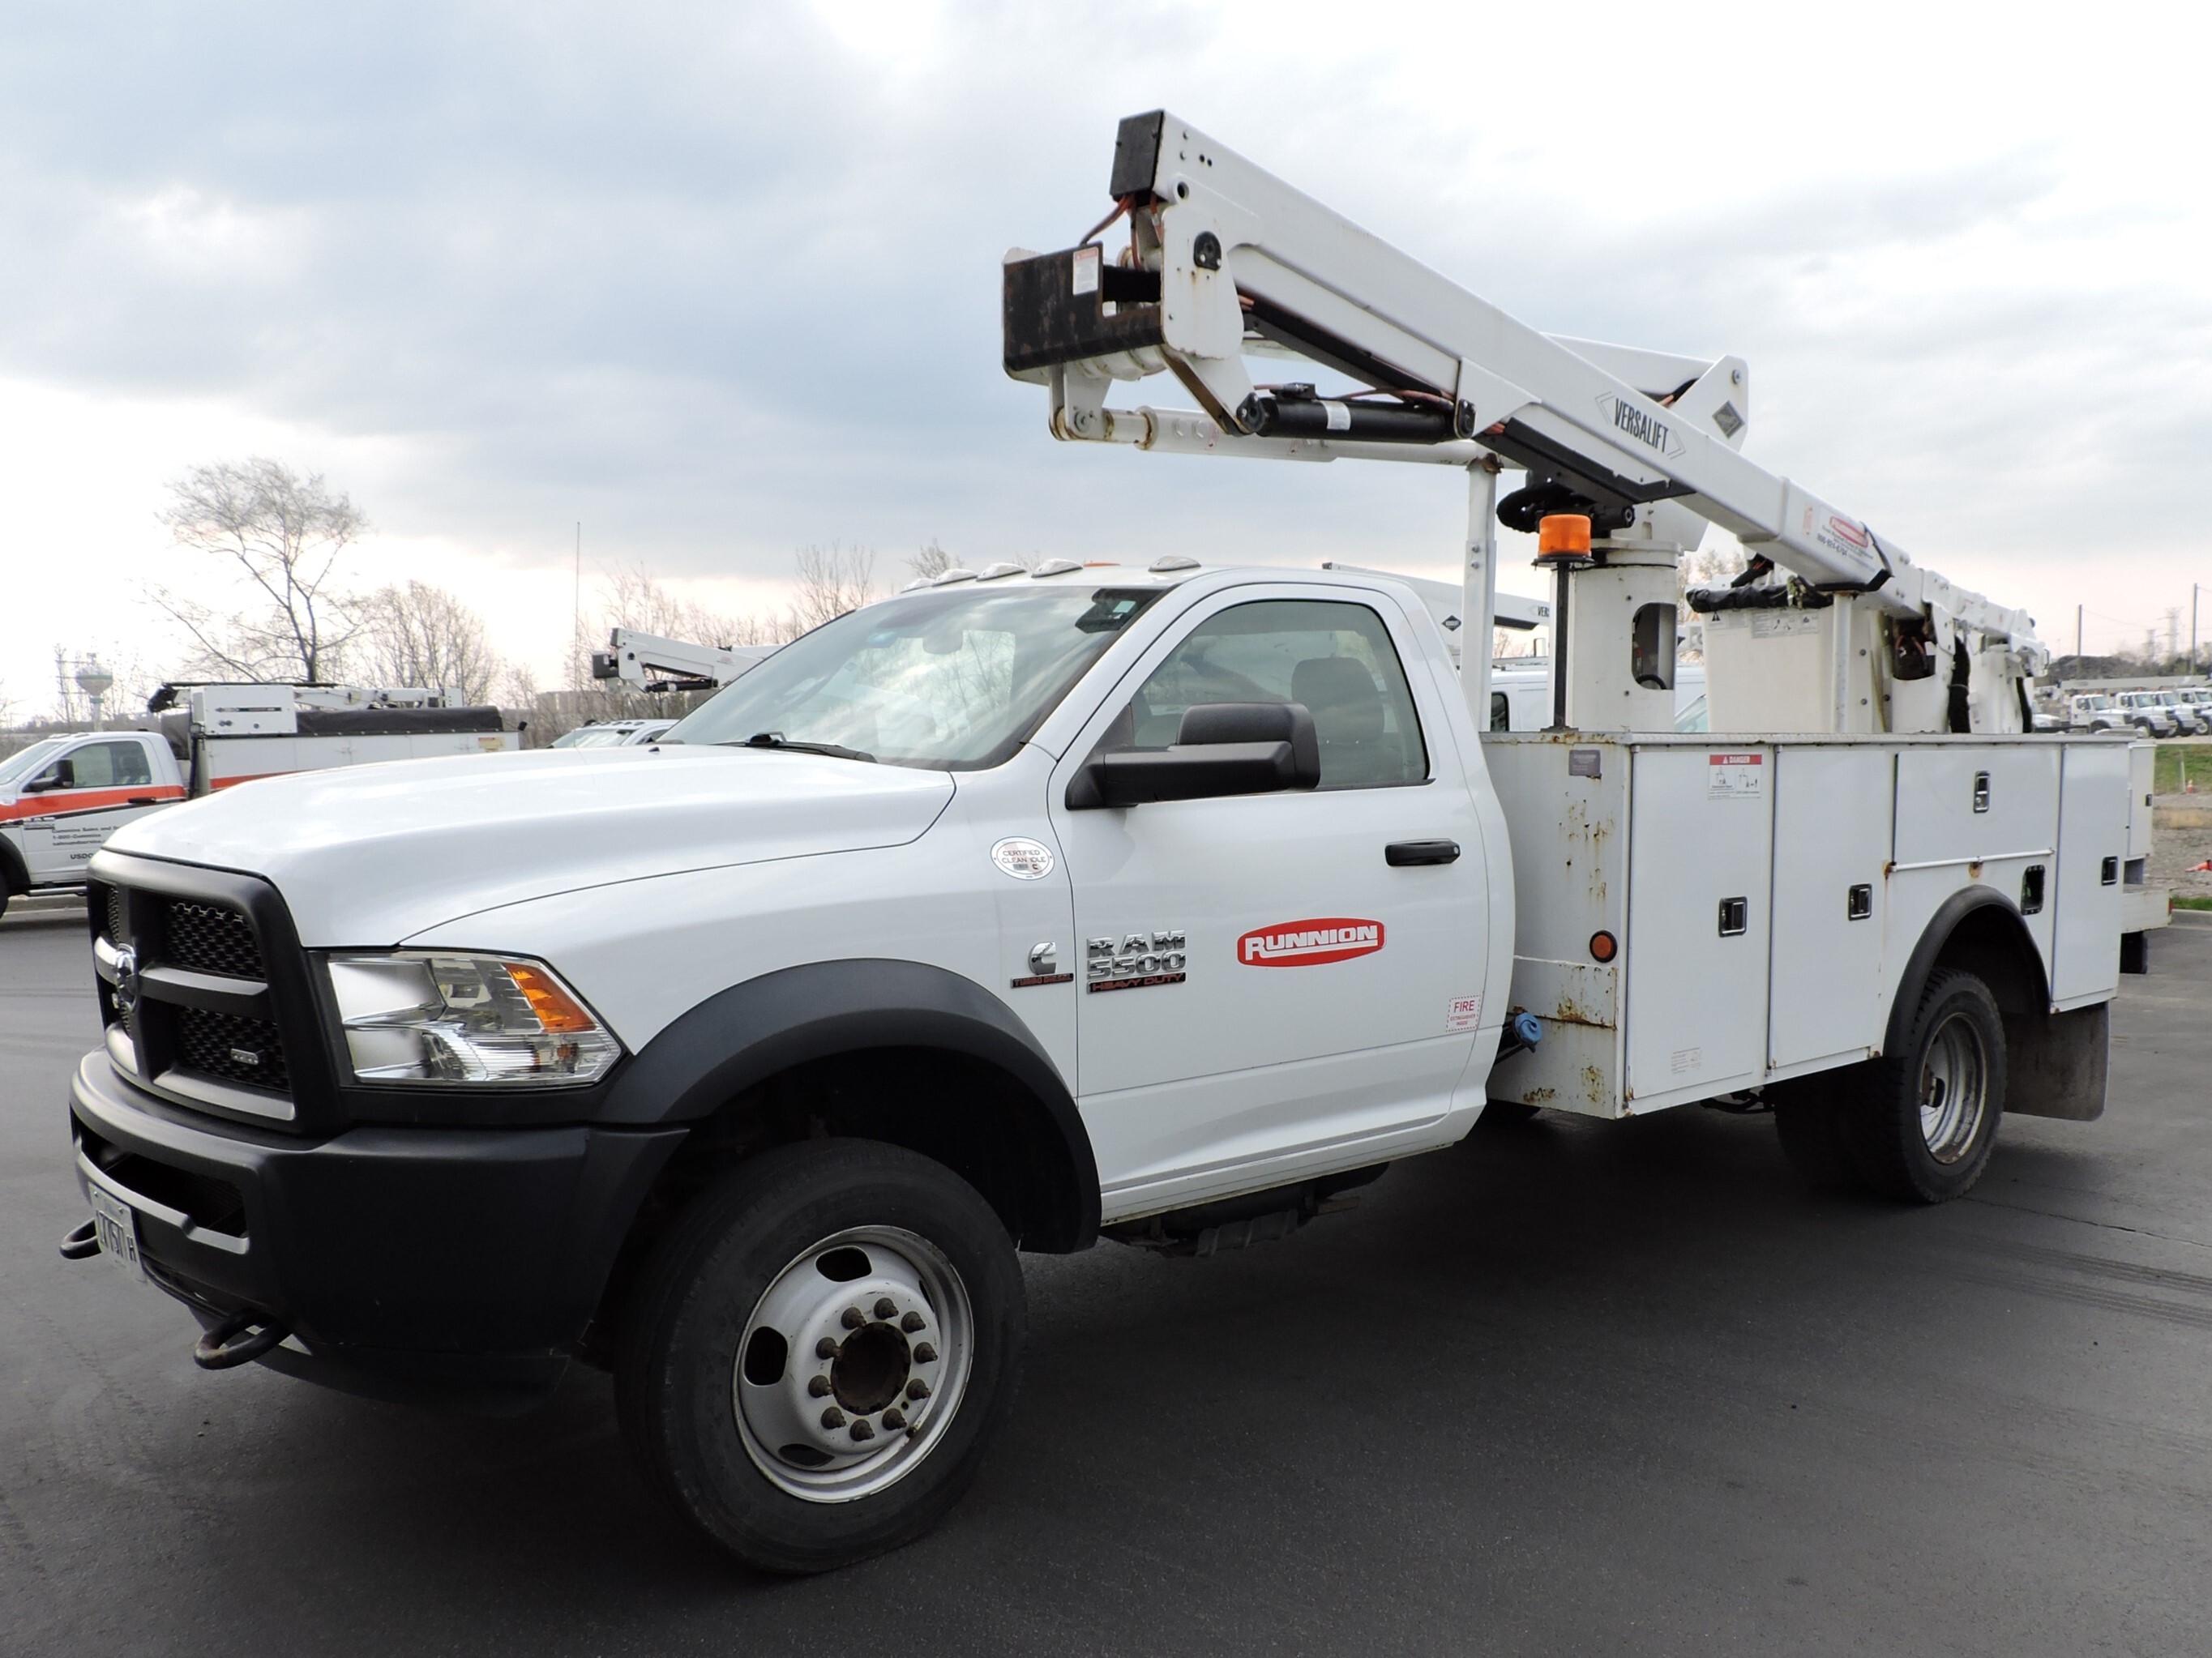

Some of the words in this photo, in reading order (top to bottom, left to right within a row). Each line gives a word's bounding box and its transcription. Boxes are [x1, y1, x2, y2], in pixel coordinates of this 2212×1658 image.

[1614, 397, 1669, 453] VERSALIFT
[1087, 929, 1186, 958] RAM
[1245, 925, 1379, 961] RUNNION
[1087, 951, 1187, 980] 5500
[1092, 978, 1141, 993] HEAVY
[1144, 973, 1183, 985] DUTY
[1453, 1000, 1475, 1013] FIRE
[127, 1234, 137, 1263] H
